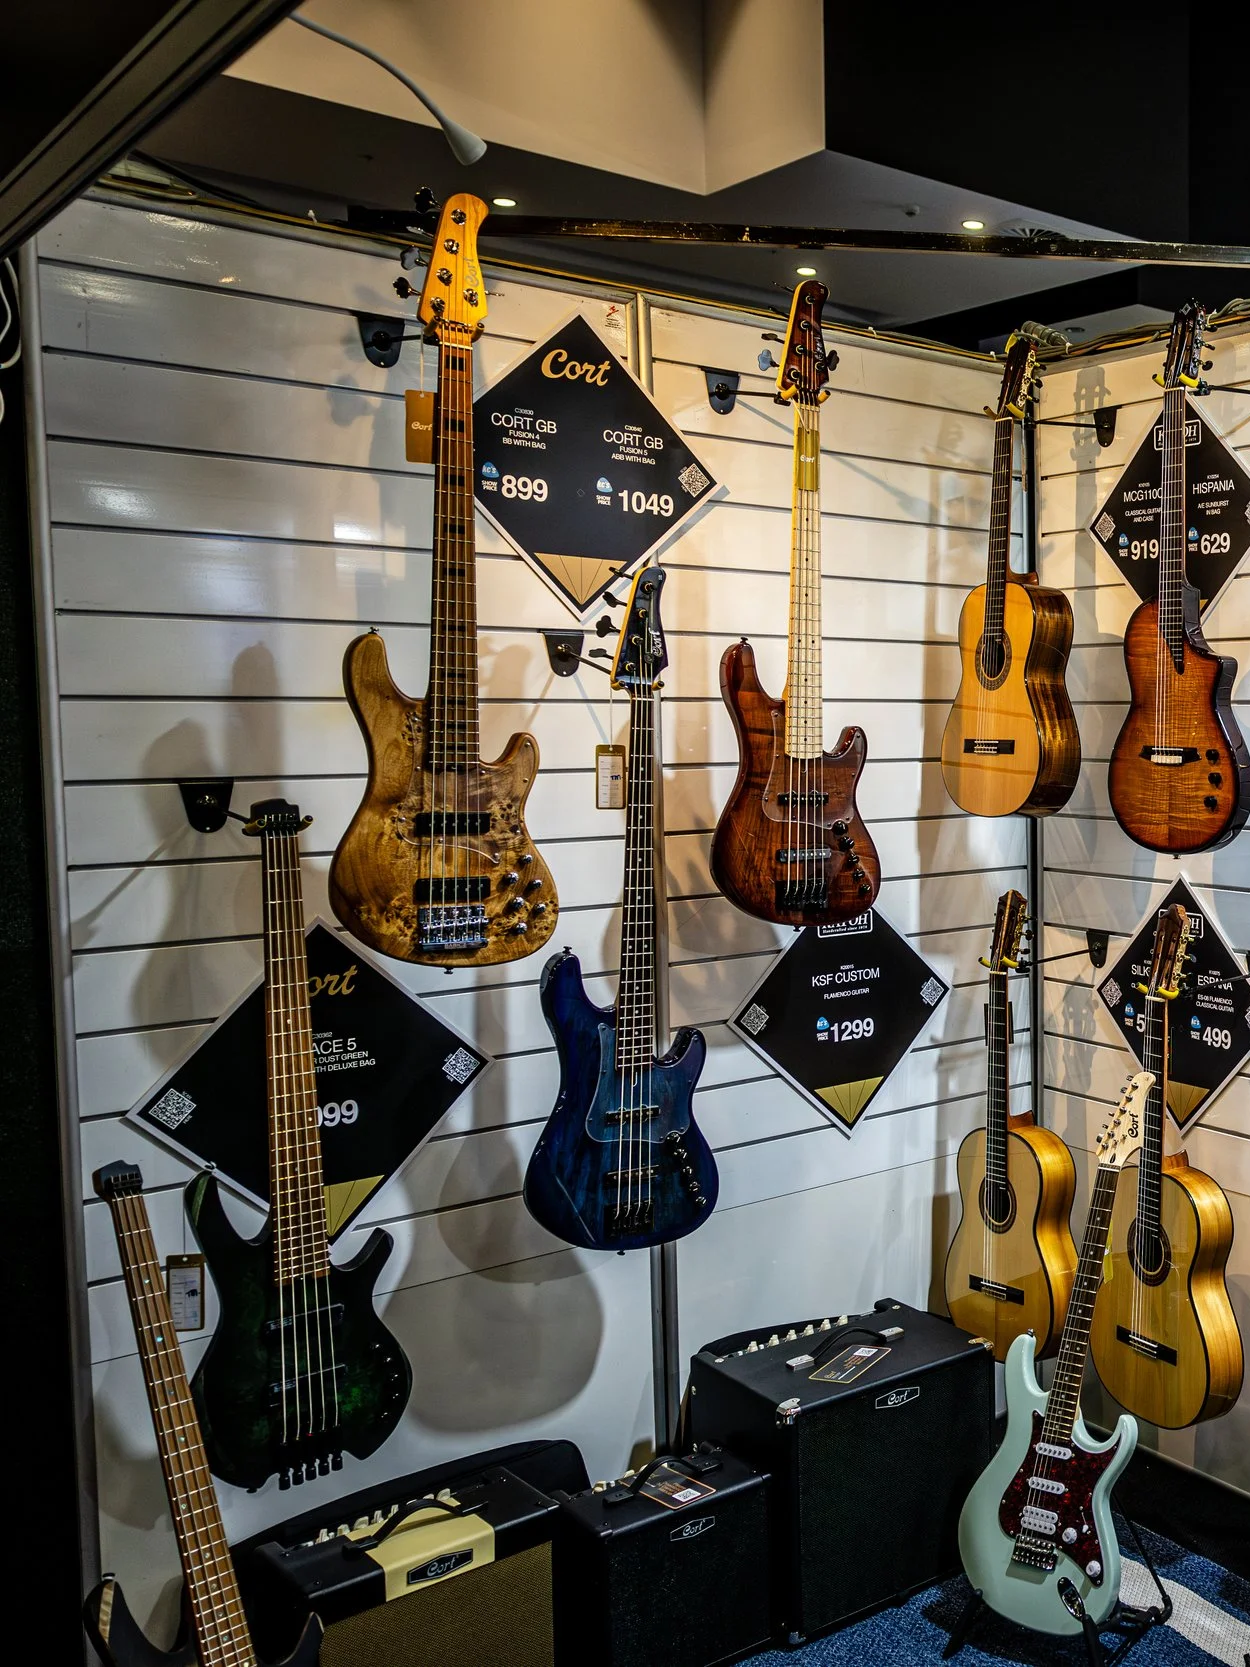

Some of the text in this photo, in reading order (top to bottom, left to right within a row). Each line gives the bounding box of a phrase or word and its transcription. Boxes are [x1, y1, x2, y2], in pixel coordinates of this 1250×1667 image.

[542, 349, 611, 386] Cort
[491, 412, 557, 433] CORT GB
[509, 430, 534, 439] FUSION
[603, 430, 663, 449] CORT GB
[513, 439, 531, 447] WITH
[532, 442, 546, 450] BAG
[620, 446, 643, 455] FUSION
[625, 455, 641, 463] WITH
[642, 457, 655, 465] BAG
[502, 474, 548, 502] 899
[1193, 480, 1235, 495] HISPANIA
[618, 490, 674, 517] 1049
[1206, 500, 1229, 508] SUNBURST
[1131, 539, 1159, 561] 919
[1201, 532, 1230, 554] 629
[309, 965, 357, 997] ort
[812, 968, 880, 987] KSF CUSTOM
[824, 990, 851, 999] FLAMENCO
[1210, 995, 1232, 1005] FLAMENCO
[1196, 1001, 1218, 1011] CLASSICAL
[830, 1018, 874, 1042] 1299
[1202, 1026, 1231, 1050] 499
[312, 1038, 357, 1055] ACE 5
[319, 1054, 339, 1064] DUST
[341, 1051, 368, 1061] GREEN
[328, 1062, 358, 1072] DELUXE
[360, 1059, 376, 1067] BAG
[1128, 1110, 1138, 1138] Cort
[888, 1391, 908, 1405] Cort
[682, 1520, 703, 1536] Cort
[427, 1556, 456, 1577] Cort
